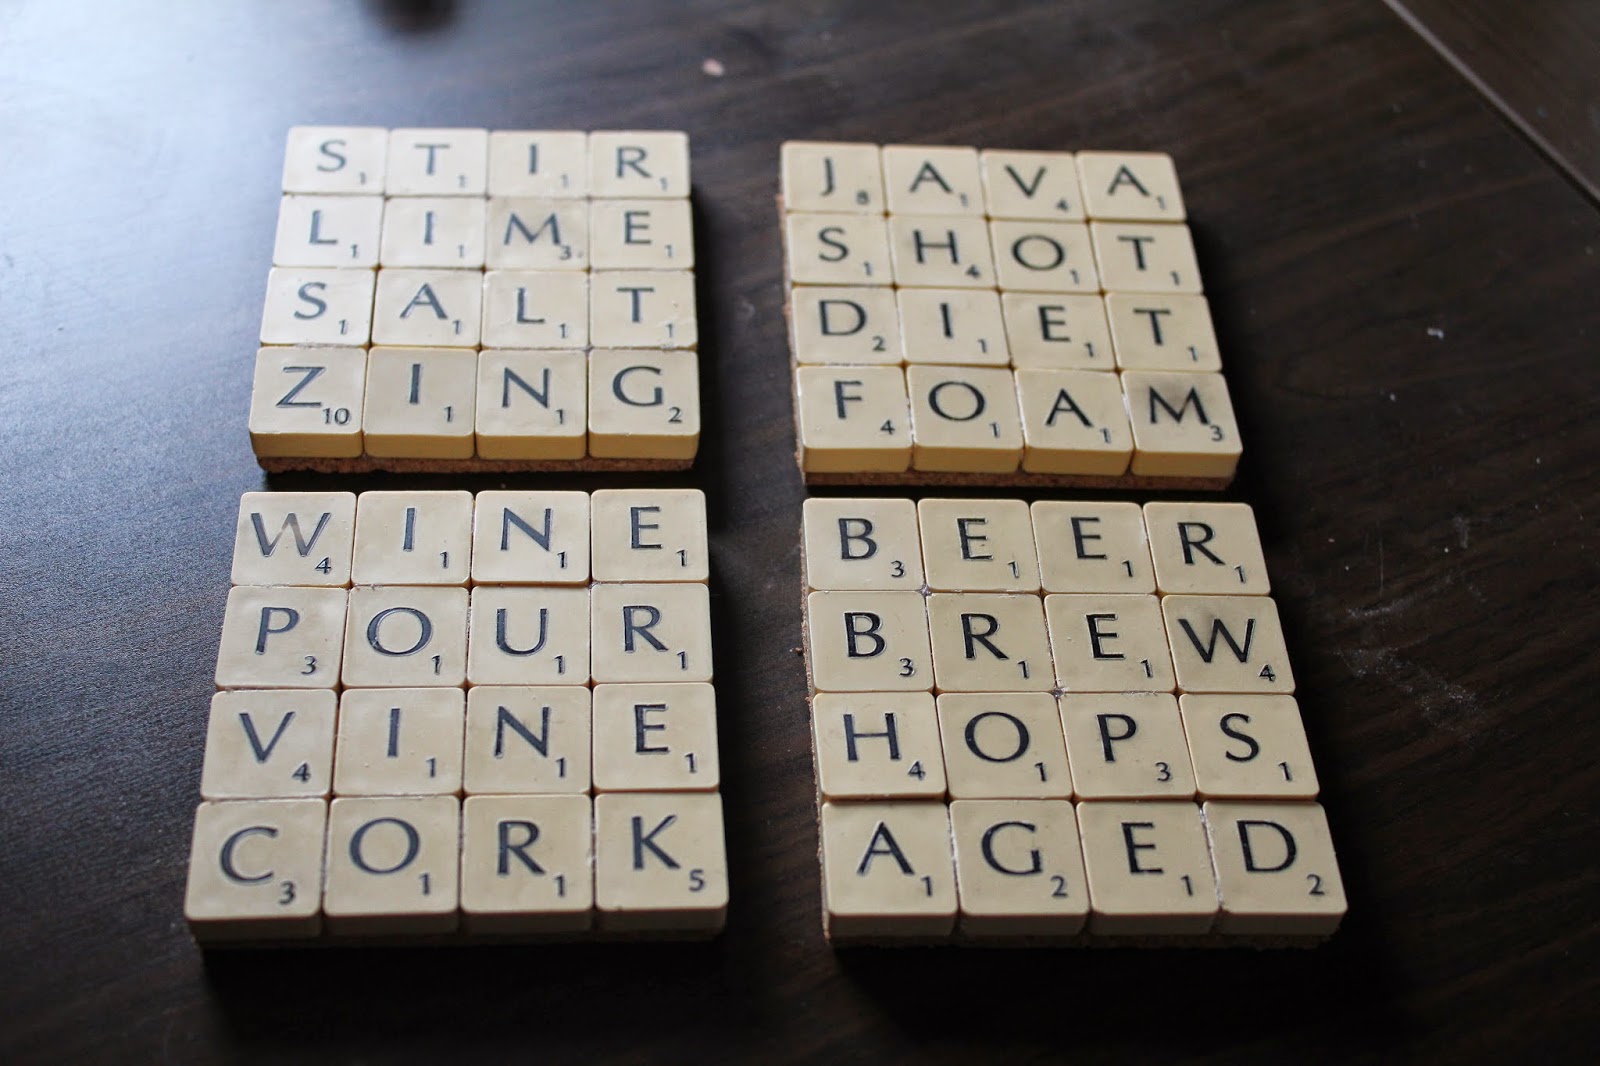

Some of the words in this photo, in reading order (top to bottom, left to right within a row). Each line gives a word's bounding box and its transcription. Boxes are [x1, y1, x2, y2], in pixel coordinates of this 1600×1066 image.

[1054, 197, 1071, 213] 4
[559, 245, 573, 261] 3
[965, 264, 982, 280] 4
[872, 335, 887, 353] 2
[322, 407, 353, 427] 10
[667, 406, 683, 425] 2
[879, 419, 896, 436] 4
[1209, 424, 1226, 443] 3
[314, 556, 332, 576] 4
[890, 559, 907, 579] 3
[300, 655, 318, 677] 3
[898, 656, 915, 679] 3
[1258, 663, 1277, 684] 4
[291, 762, 312, 785] 4
[906, 760, 927, 782] 4
[1154, 761, 1174, 784] 3
[688, 868, 706, 893] 5
[1050, 874, 1069, 899] 2
[1306, 873, 1326, 898] 2
[278, 880, 297, 906] 3
